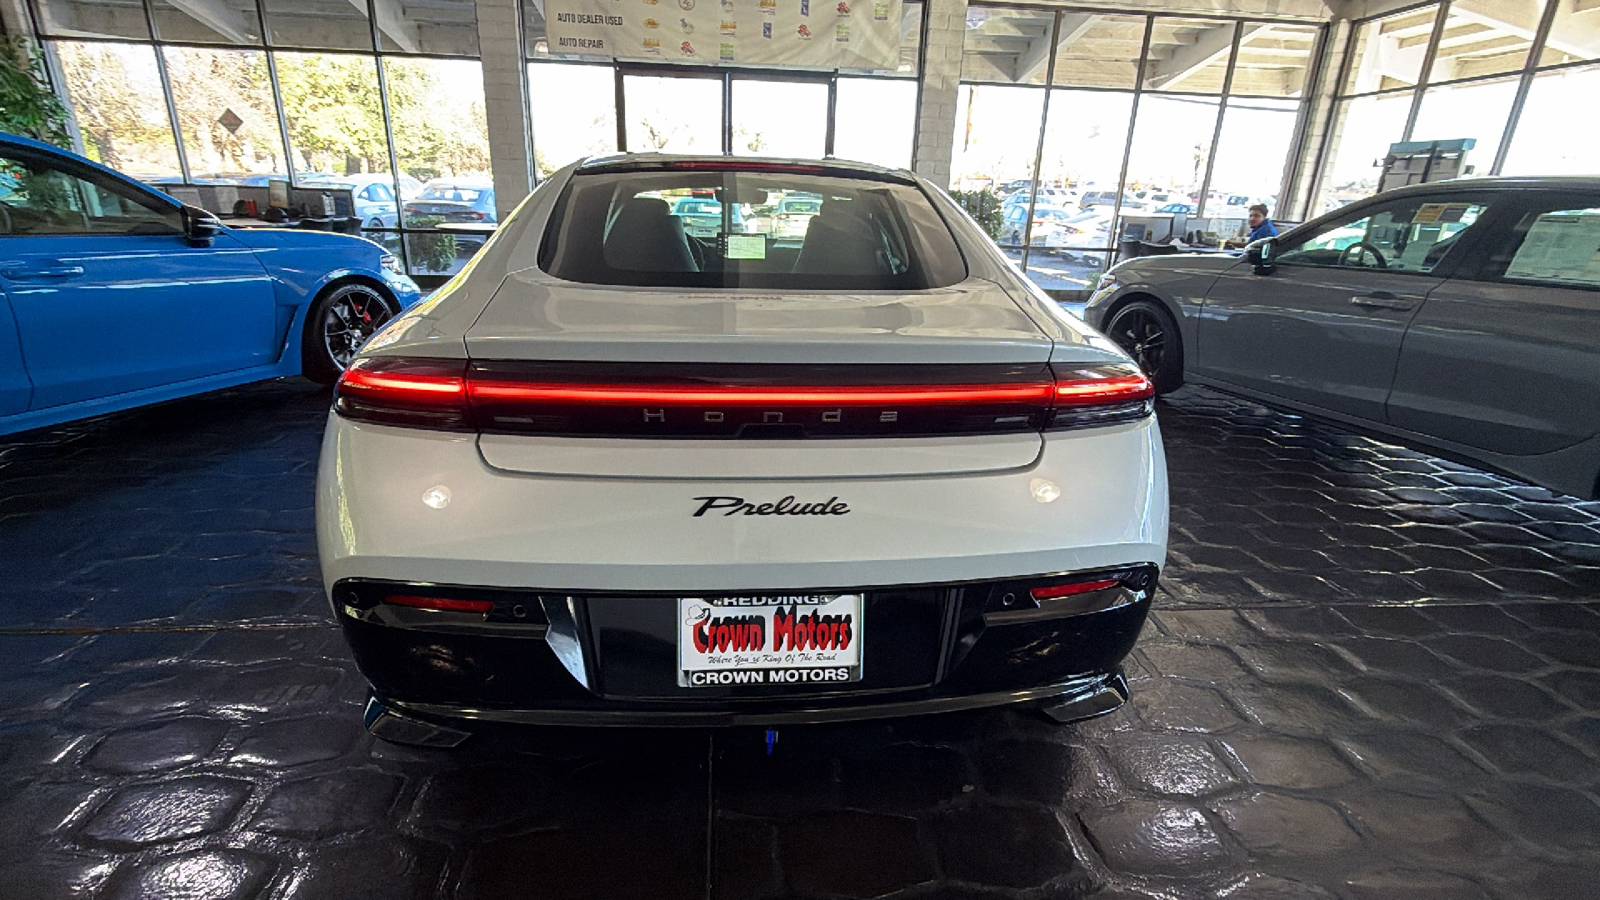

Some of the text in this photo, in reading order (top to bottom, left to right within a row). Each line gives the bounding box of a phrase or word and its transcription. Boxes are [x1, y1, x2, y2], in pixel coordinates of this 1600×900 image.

[557, 13, 623, 26] AUTO DEALER USED
[559, 37, 604, 49] AUTO REPAIR
[692, 495, 851, 517] Prelude
[723, 595, 819, 606] REDDING
[692, 604, 852, 653] Crown Motors
[708, 655, 732, 664] Where
[762, 654, 782, 664] King
[784, 654, 795, 664] Of
[798, 653, 812, 662] The
[814, 653, 837, 661] Road
[692, 668, 849, 685] CROWN MOTORS
